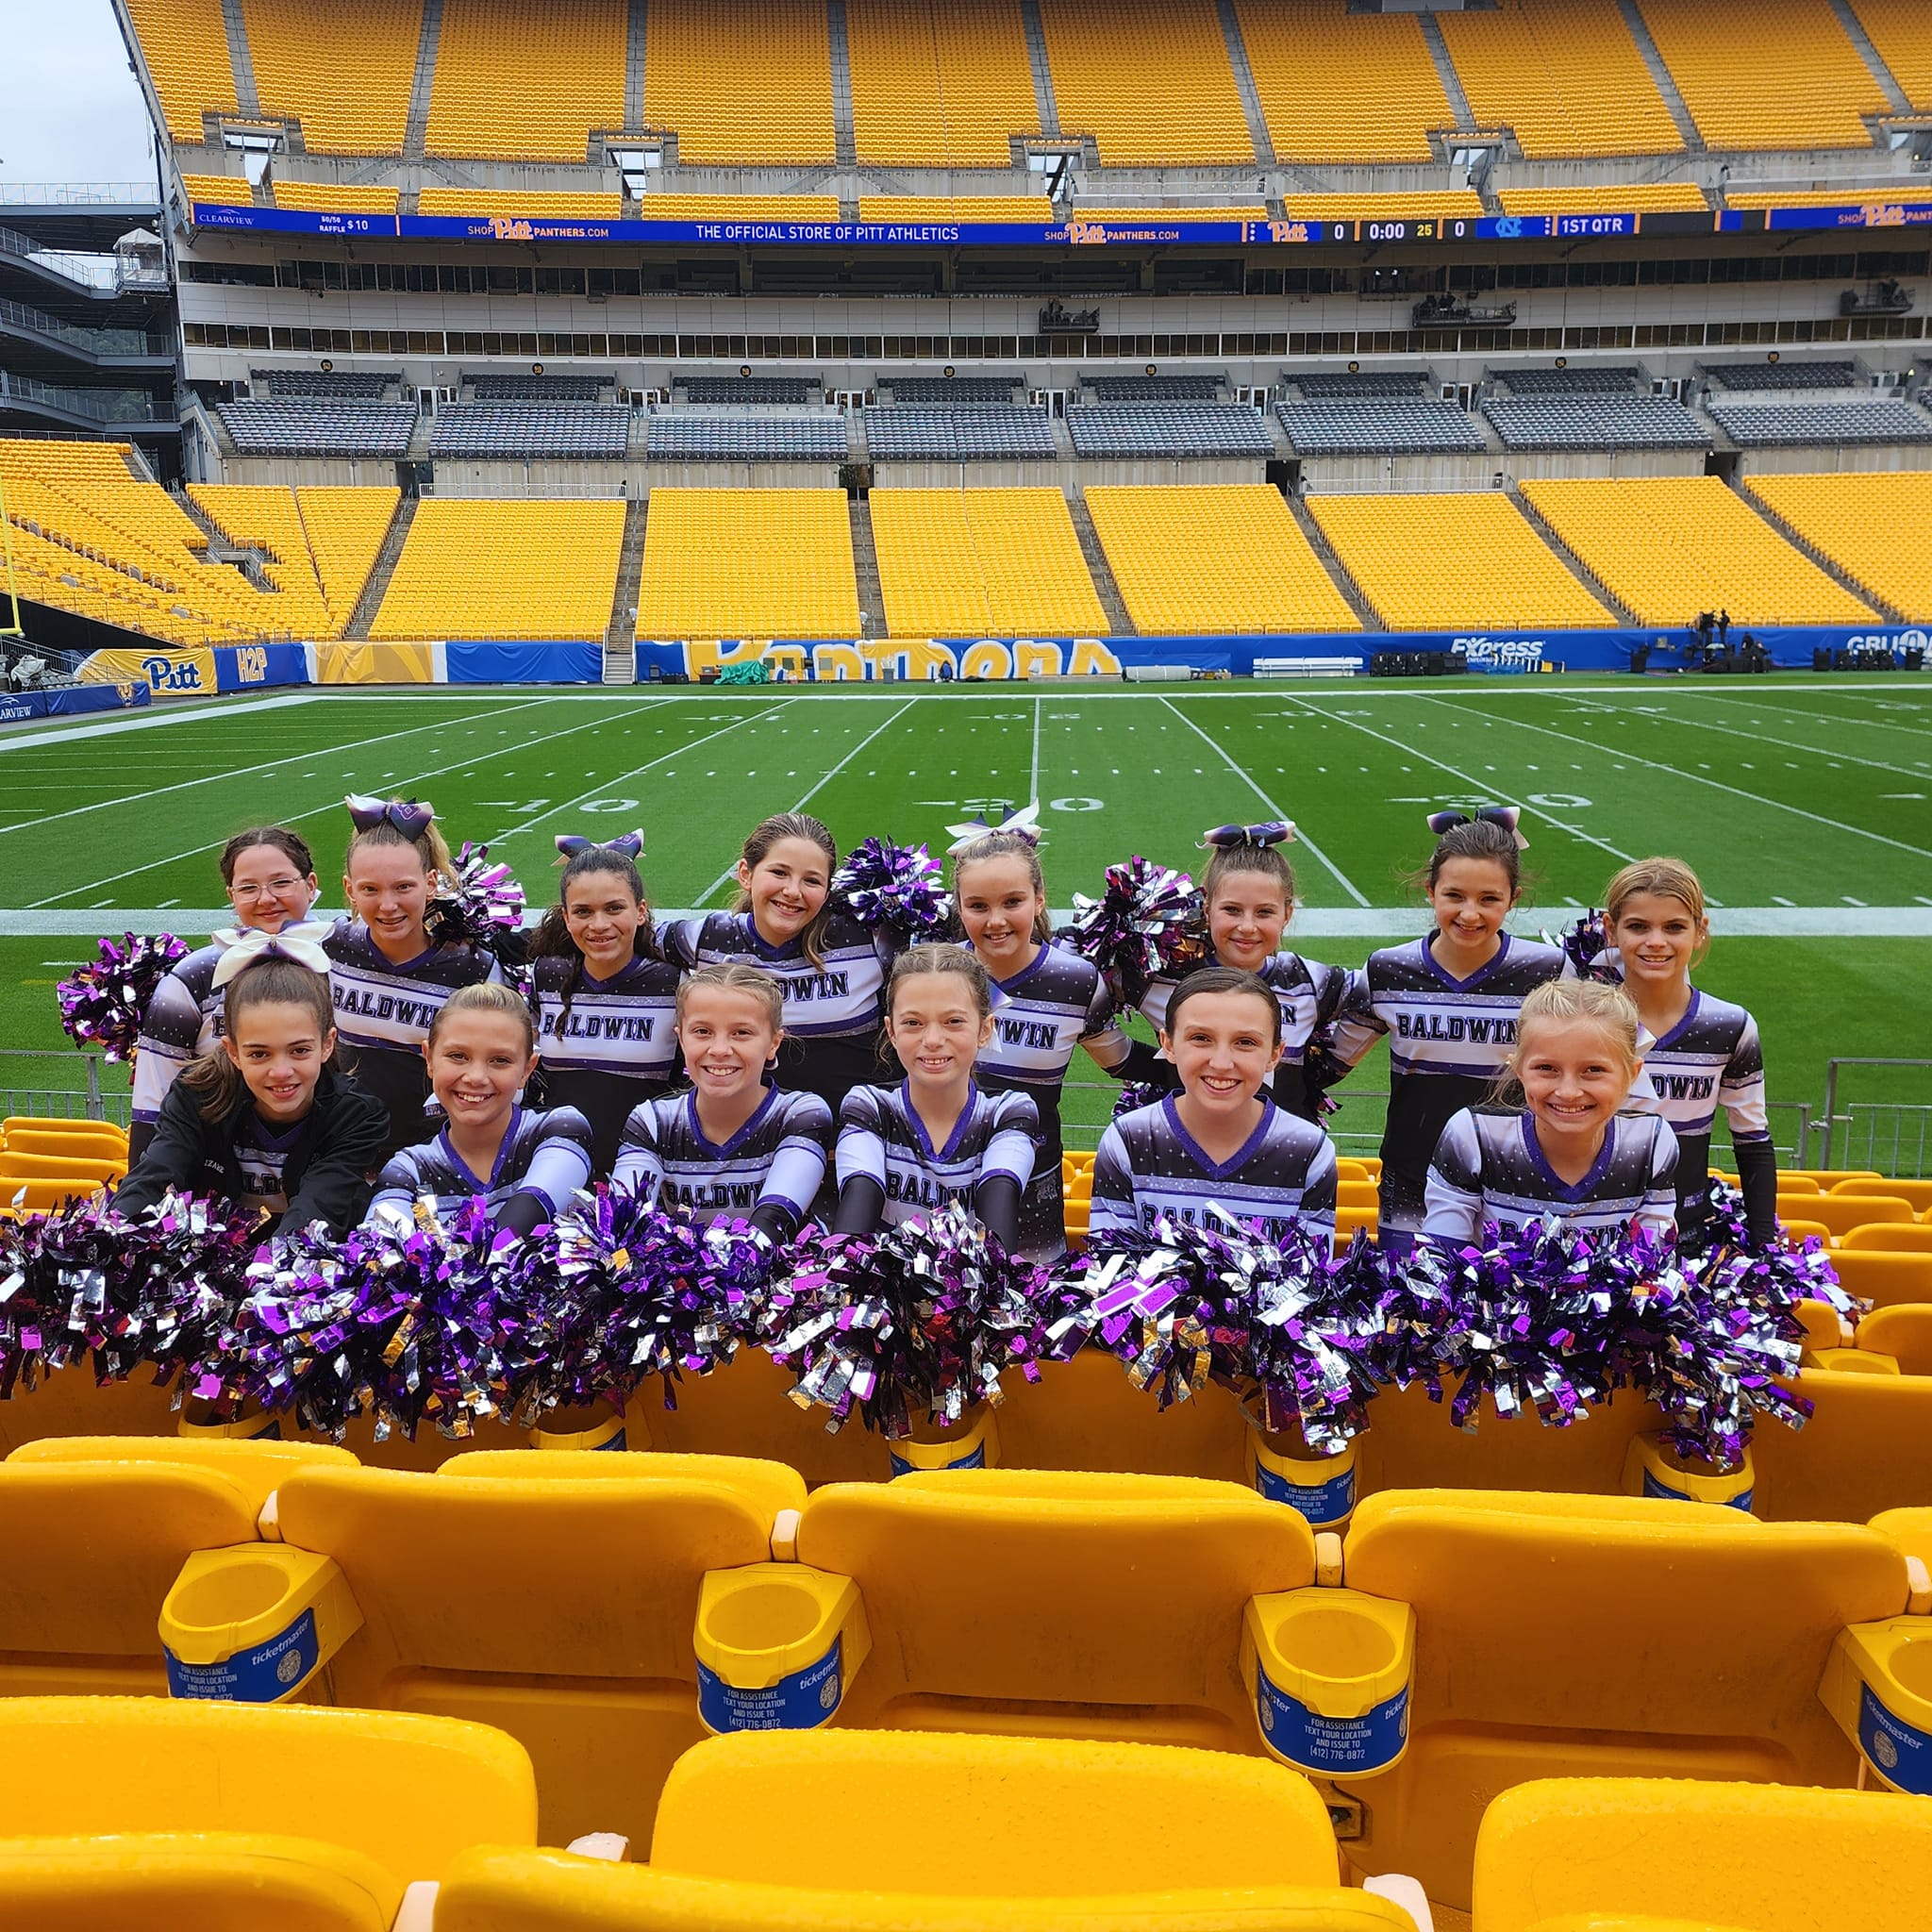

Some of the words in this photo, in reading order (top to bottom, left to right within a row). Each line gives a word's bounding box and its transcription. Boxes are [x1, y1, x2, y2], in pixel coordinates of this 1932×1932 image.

[199, 214, 254, 226] CLEARVIEW
[1562, 219, 1590, 234] 1ST
[1591, 218, 1623, 233] QTR
[468, 225, 493, 235] SHOP
[489, 217, 534, 240] Pitt
[534, 227, 608, 237] PANTHERS.COM
[696, 225, 721, 239] THE
[725, 225, 785, 240] OFFICIAL
[789, 226, 831, 240] STORE
[835, 226, 853, 240] OF
[857, 226, 884, 241] PITT
[888, 227, 958, 241] ATHLETICS
[1044, 231, 1070, 241] SHOP
[1064, 223, 1107, 244] Pitt
[1108, 231, 1179, 241] PANTHERS.COM
[1267, 221, 1308, 242] Pitt
[1334, 224, 1344, 240] 0
[1370, 223, 1405, 240] 0:00
[1417, 224, 1432, 237] 25
[1455, 221, 1464, 237] 0
[236, 647, 268, 683] H2P
[142, 656, 203, 691] Pitt
[772, 971, 849, 1003] DWIN
[333, 983, 442, 1029] BALDWI
[1649, 1073, 1716, 1100] DWIN
[251, 1619, 309, 1666] ticketmaster
[207, 1674, 237, 1685] LOCATION
[217, 1685, 226, 1693] TO
[727, 1690, 740, 1699] FOR
[741, 1690, 778, 1701] ASSISTANCE
[723, 1697, 736, 1707] TEXT
[738, 1699, 754, 1709] YOUR
[755, 1699, 786, 1709] LOCATION
[733, 1708, 745, 1718] AND
[747, 1710, 765, 1719] ISSUE
[766, 1709, 774, 1718] TO
[729, 1716, 745, 1728] (412)
[1311, 1718, 1324, 1728] FOR
[1325, 1720, 1366, 1730] ASSISTANCE
[1305, 1725, 1320, 1737] TEXT
[1322, 1728, 1341, 1740] YOUR
[1341, 1729, 1372, 1740] LOCATION
[1316, 1739, 1329, 1748] AND
[1331, 1740, 1351, 1749] ISSUE
[1352, 1740, 1360, 1749] TO
[1310, 1745, 1328, 1759] (412)
[1330, 1749, 1366, 1760] 776-0872
